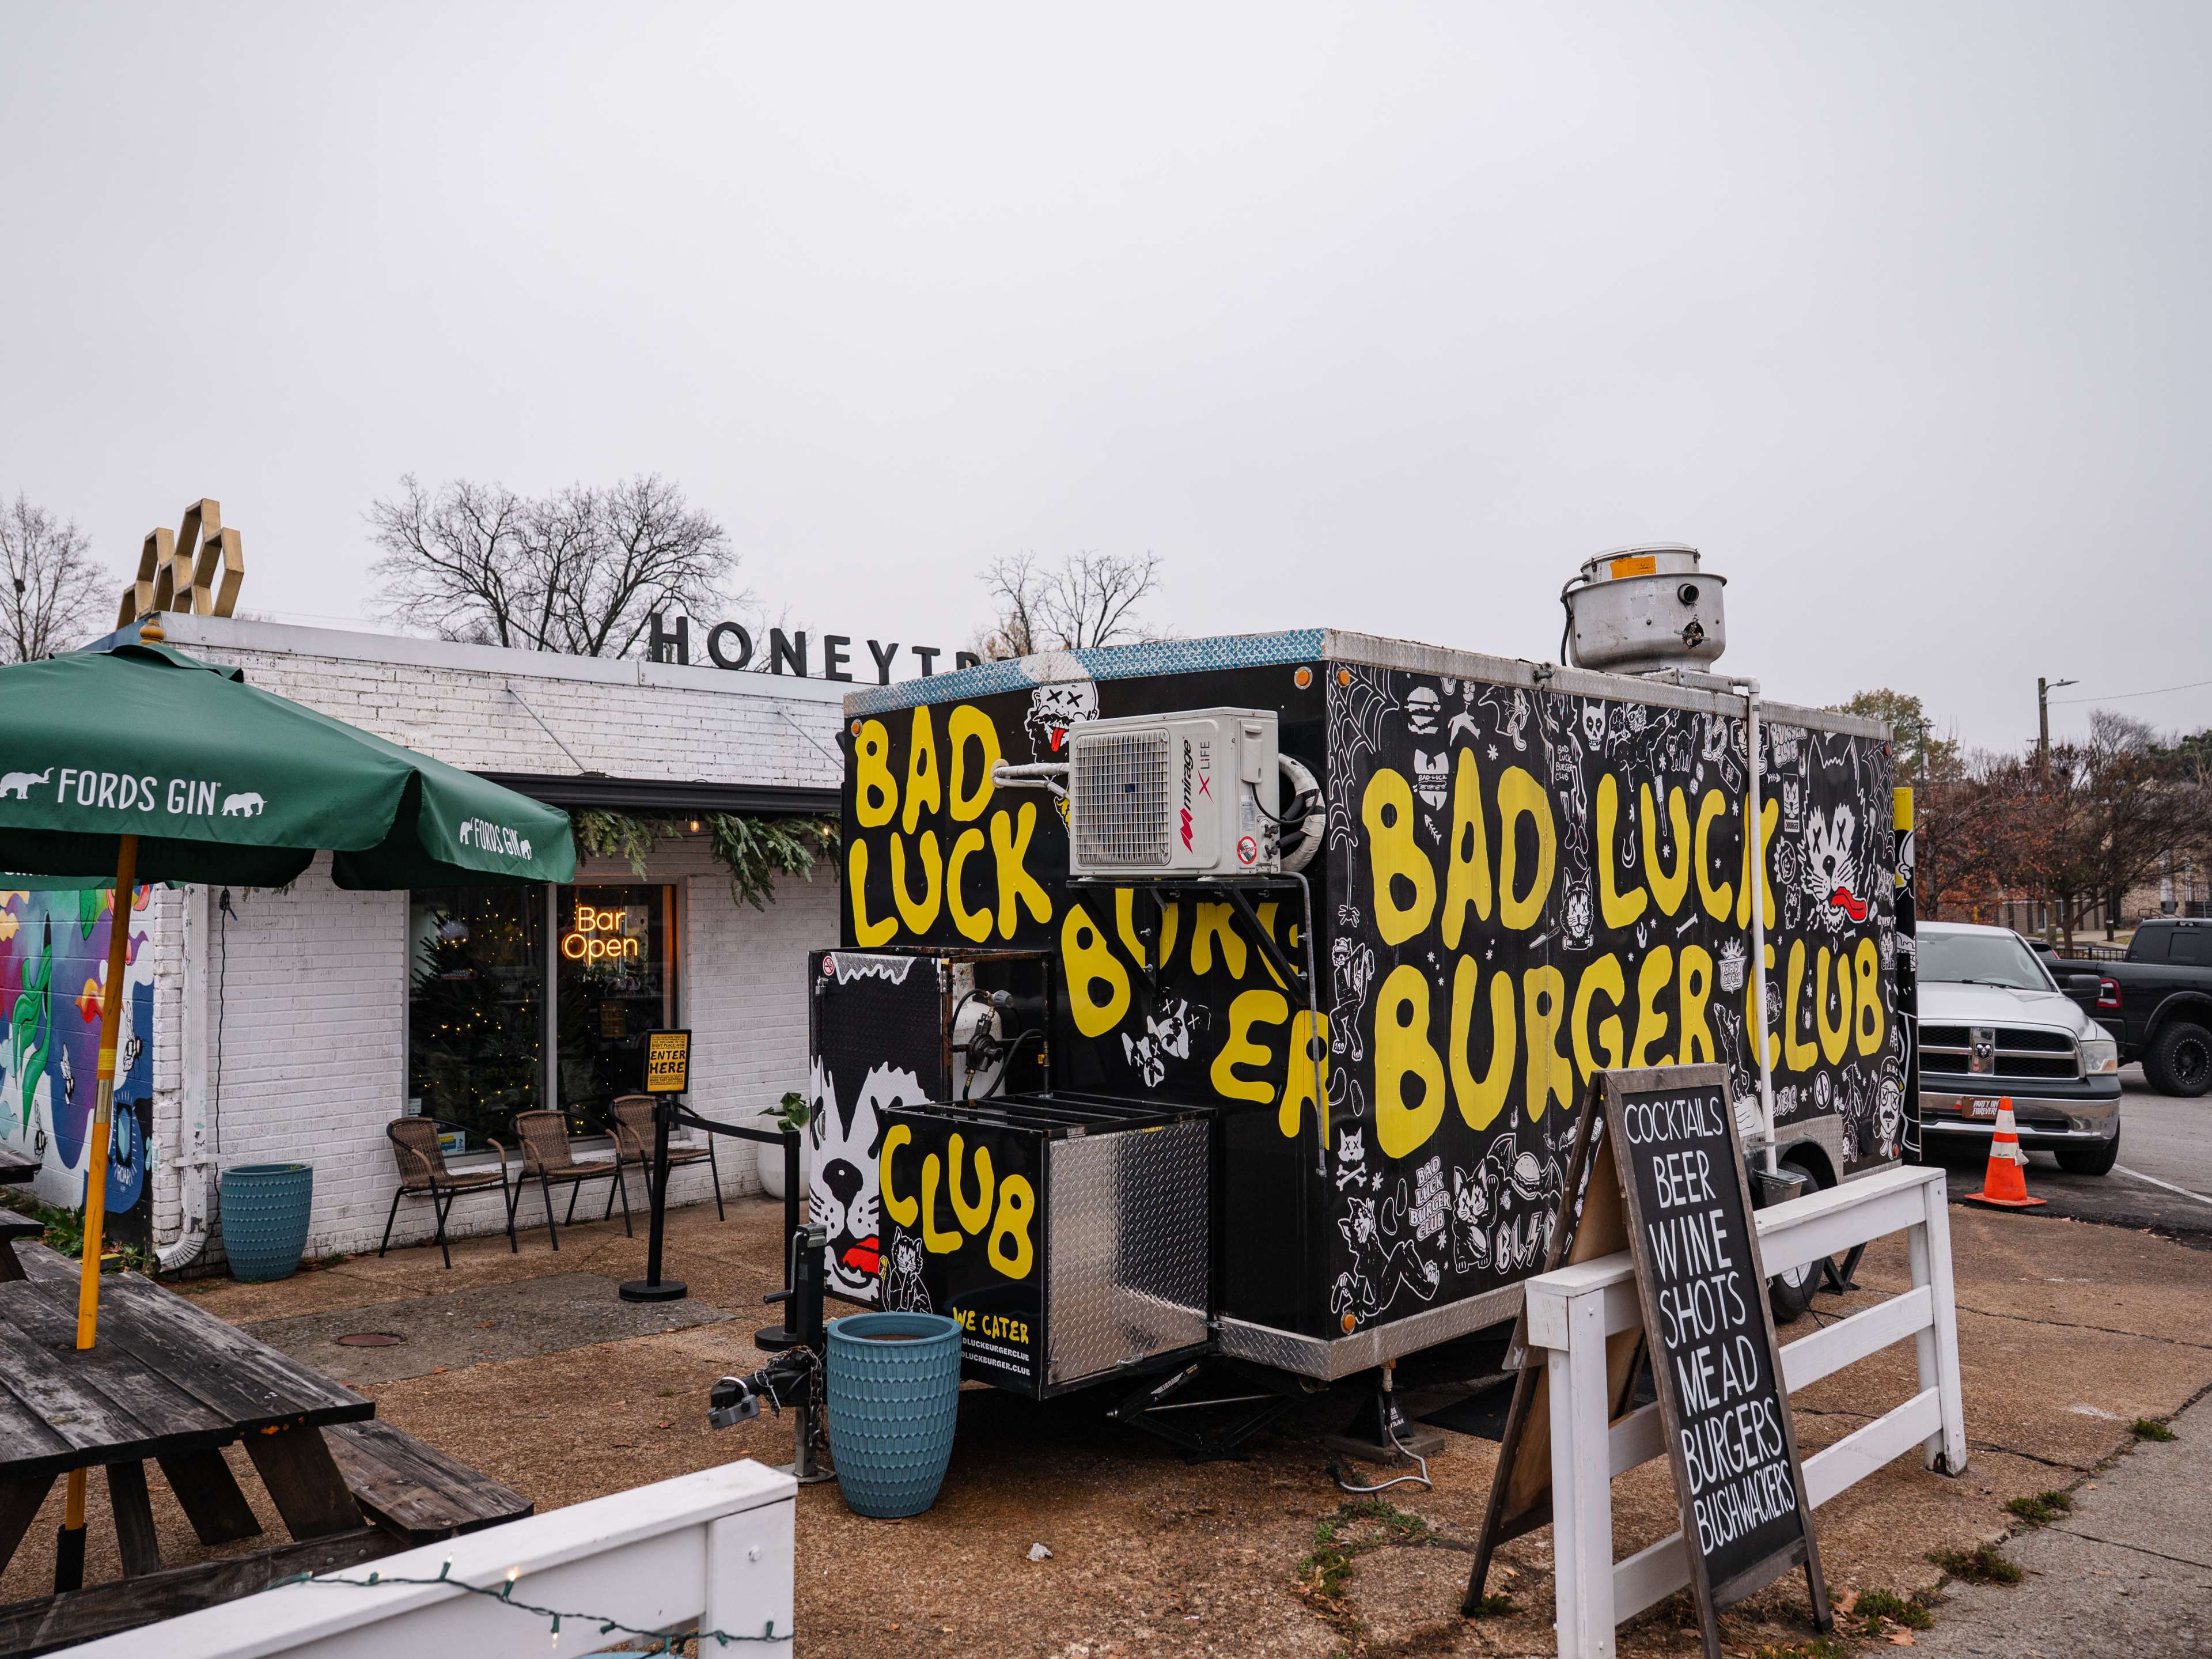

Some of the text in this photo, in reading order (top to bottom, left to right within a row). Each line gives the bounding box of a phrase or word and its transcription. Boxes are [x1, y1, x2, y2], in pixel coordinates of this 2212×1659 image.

[1555, 762, 1574, 772] BURGER
[1557, 745, 1569, 754] BAD
[1559, 753, 1573, 763] LUCK
[855, 705, 1001, 835] BAD
[1182, 739, 1194, 812] mirage
[1555, 771, 1569, 781] CLUB
[58, 768, 157, 812] FORDS
[475, 818, 504, 854] FORDS
[1362, 747, 1557, 950] BAD
[849, 802, 1053, 948] LUCK
[578, 907, 627, 931] Bar
[564, 933, 638, 966] Open
[650, 1050, 685, 1060] ENTER
[1375, 938, 1884, 1159] BURGER CLUB
[649, 1062, 685, 1074] HERE
[1624, 1097, 1723, 1144] COCKTAILS
[1972, 1107, 1997, 1116] FOREVER!
[1973, 1100, 1990, 1108] PARTY
[1416, 1157, 1440, 1186] BAD
[1416, 1173, 1444, 1206] LUCK
[1653, 1150, 1716, 1209] BEER
[880, 1124, 1035, 1279] CLUB
[1410, 1191, 1451, 1225] BURGER
[1417, 1211, 1444, 1240] CLUB
[1649, 1209, 1732, 1282] WINE
[953, 1306, 1029, 1344] WE CATER
[1660, 1271, 1746, 1349] SHOTS
[963, 1337, 1029, 1361] DLUCKBURGERCLUB
[1677, 1335, 1758, 1417] MEAD
[1681, 1397, 1782, 1495] BURGERS
[1694, 1460, 1796, 1556] BUSHWACKERS
